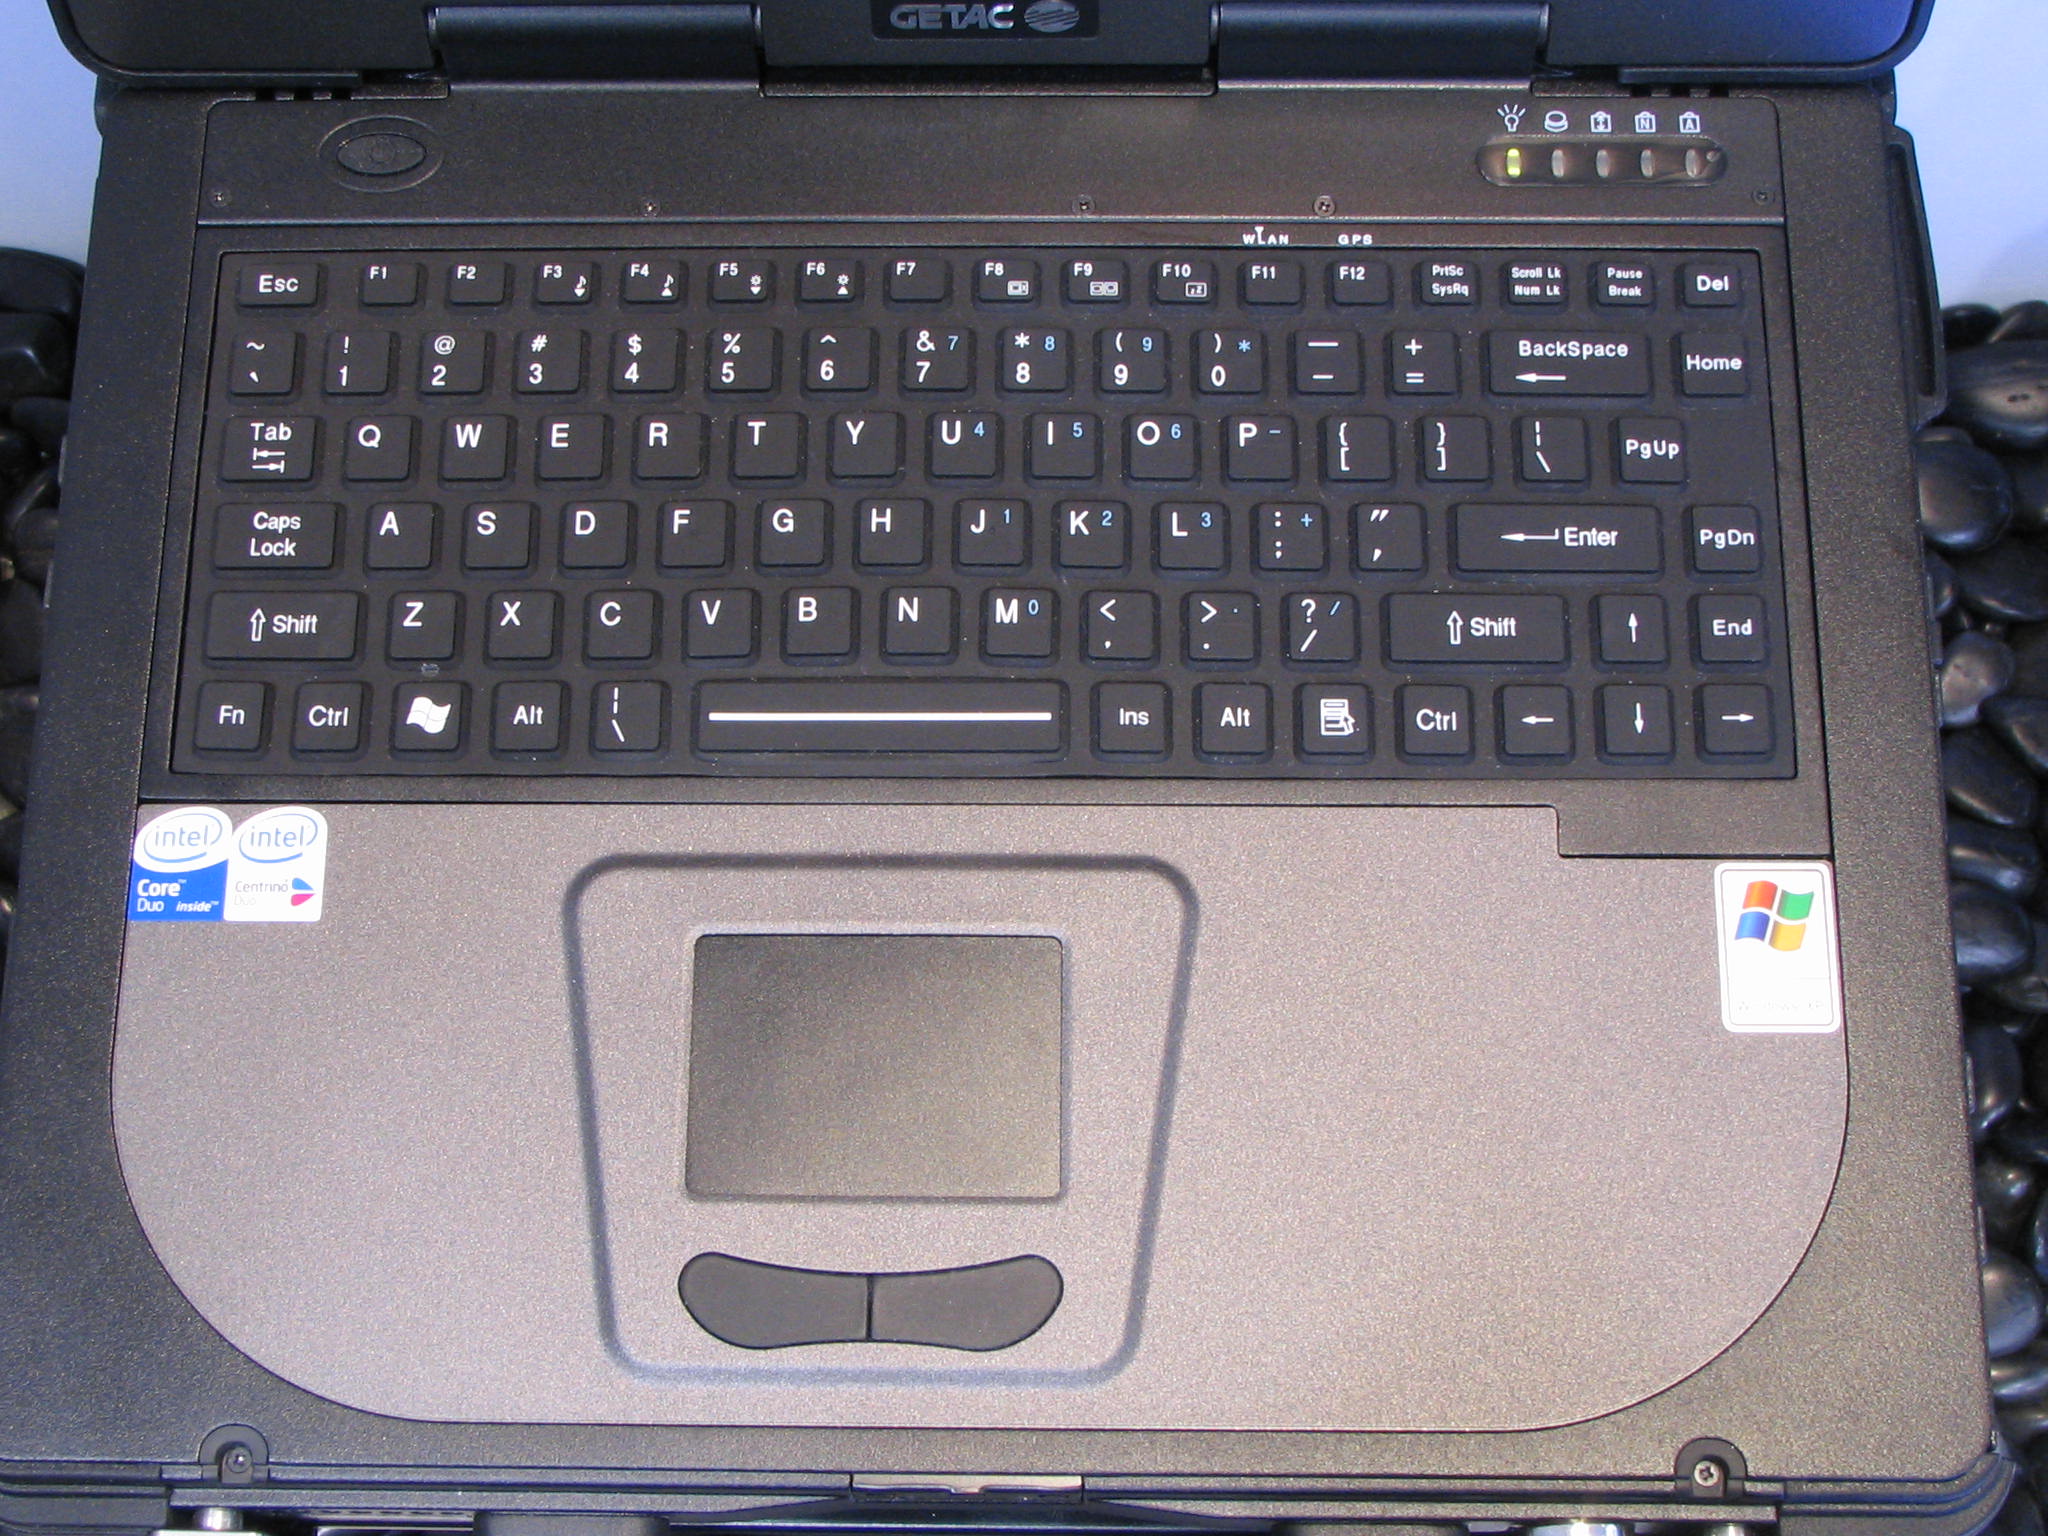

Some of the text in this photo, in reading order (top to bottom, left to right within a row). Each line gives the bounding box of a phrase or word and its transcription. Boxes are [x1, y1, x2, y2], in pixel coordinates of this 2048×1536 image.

[890, 3, 1014, 30] GETAC
[1242, 225, 1289, 245] WLAN
[1337, 234, 1373, 245] GPS
[369, 265, 387, 280] F1
[456, 264, 477, 280] F2
[542, 264, 563, 279] F3
[630, 262, 650, 278] F4
[719, 262, 739, 277] F5
[806, 261, 826, 276] F6
[896, 260, 917, 276] F7
[984, 261, 1005, 277] F8
[1073, 261, 1093, 277] F9
[1162, 262, 1192, 278] F10
[1251, 264, 1276, 280] F11
[1339, 265, 1366, 281] F12
[1511, 266, 1562, 279] Scroll Lk
[1606, 266, 1644, 280] Pause
[256, 273, 299, 294] Esc
[1431, 282, 1469, 297] SysRq
[1514, 284, 1561, 296] Num Lk
[1608, 284, 1642, 297] Break
[1696, 274, 1730, 292] Del
[246, 341, 265, 351] ~
[433, 334, 456, 356] @
[530, 334, 548, 353] #
[627, 333, 642, 356] $
[722, 332, 741, 355] %
[820, 334, 837, 344] ^
[915, 329, 936, 353] &
[948, 335, 959, 351] 7
[1044, 335, 1056, 352] 8
[1142, 336, 1153, 352] 9
[1404, 338, 1423, 356] +
[1518, 339, 1629, 361] BackSpace
[624, 361, 640, 384] 4
[720, 360, 735, 384] 5
[819, 358, 835, 382] 6
[915, 360, 931, 383] 7
[1015, 361, 1031, 385] 8
[1686, 353, 1743, 371] Home
[339, 365, 348, 387] 1
[430, 364, 447, 387] 2
[528, 362, 543, 385] 3
[1113, 363, 1129, 386] 9
[1210, 364, 1227, 388] 0
[1405, 371, 1425, 384] =
[250, 421, 292, 442] Tab
[357, 423, 382, 449] Q
[455, 423, 483, 449] W
[550, 422, 570, 449] E
[648, 421, 669, 447] R
[747, 420, 767, 446] T
[845, 420, 865, 446] Y
[941, 419, 962, 446] U
[973, 421, 985, 437] 4
[1047, 420, 1054, 446] I
[1072, 421, 1083, 438] 5
[1136, 420, 1161, 446] O
[1170, 423, 1182, 440] 6
[1238, 421, 1258, 448] P
[1625, 438, 1680, 460] PgUp
[1535, 450, 1551, 474] \
[252, 510, 302, 534] Caps
[378, 510, 400, 536] A
[476, 510, 497, 536] S
[574, 509, 596, 536] D
[672, 508, 691, 535] F
[771, 507, 795, 533] G
[870, 507, 892, 533] H
[970, 508, 986, 534] J
[1003, 508, 1010, 524] 1
[1069, 509, 1090, 536] K
[1101, 509, 1113, 527] 2
[1171, 511, 1189, 538] L
[1201, 511, 1212, 528] 3
[1300, 512, 1313, 528] +
[249, 537, 297, 557] Lock
[1563, 526, 1619, 547] Enter
[1699, 528, 1756, 550] PgDn
[402, 600, 424, 628] Z
[499, 600, 521, 627] X
[599, 600, 622, 627] C
[700, 599, 722, 626] V
[797, 596, 818, 623] B
[897, 596, 919, 623] N
[994, 597, 1019, 625] M
[1027, 598, 1040, 616] 0
[1099, 598, 1116, 622] <
[1200, 600, 1218, 624] >
[1300, 598, 1317, 624] ?
[1329, 600, 1341, 616] /
[271, 614, 319, 634] Shift
[1469, 616, 1517, 638] Shift
[1712, 618, 1753, 637] End
[1300, 628, 1318, 653] /
[218, 704, 245, 725] Fn
[307, 704, 349, 728] Ctrl
[512, 704, 544, 725] Alt
[1119, 707, 1150, 727] Ins
[1220, 706, 1251, 728] Alt
[1415, 707, 1458, 732] Ctrl
[611, 718, 625, 743] \
[154, 825, 209, 847] intel
[249, 825, 305, 847] intel
[137, 879, 181, 897] Core
[234, 880, 289, 893] Centrino
[137, 897, 213, 913] Duo inside
